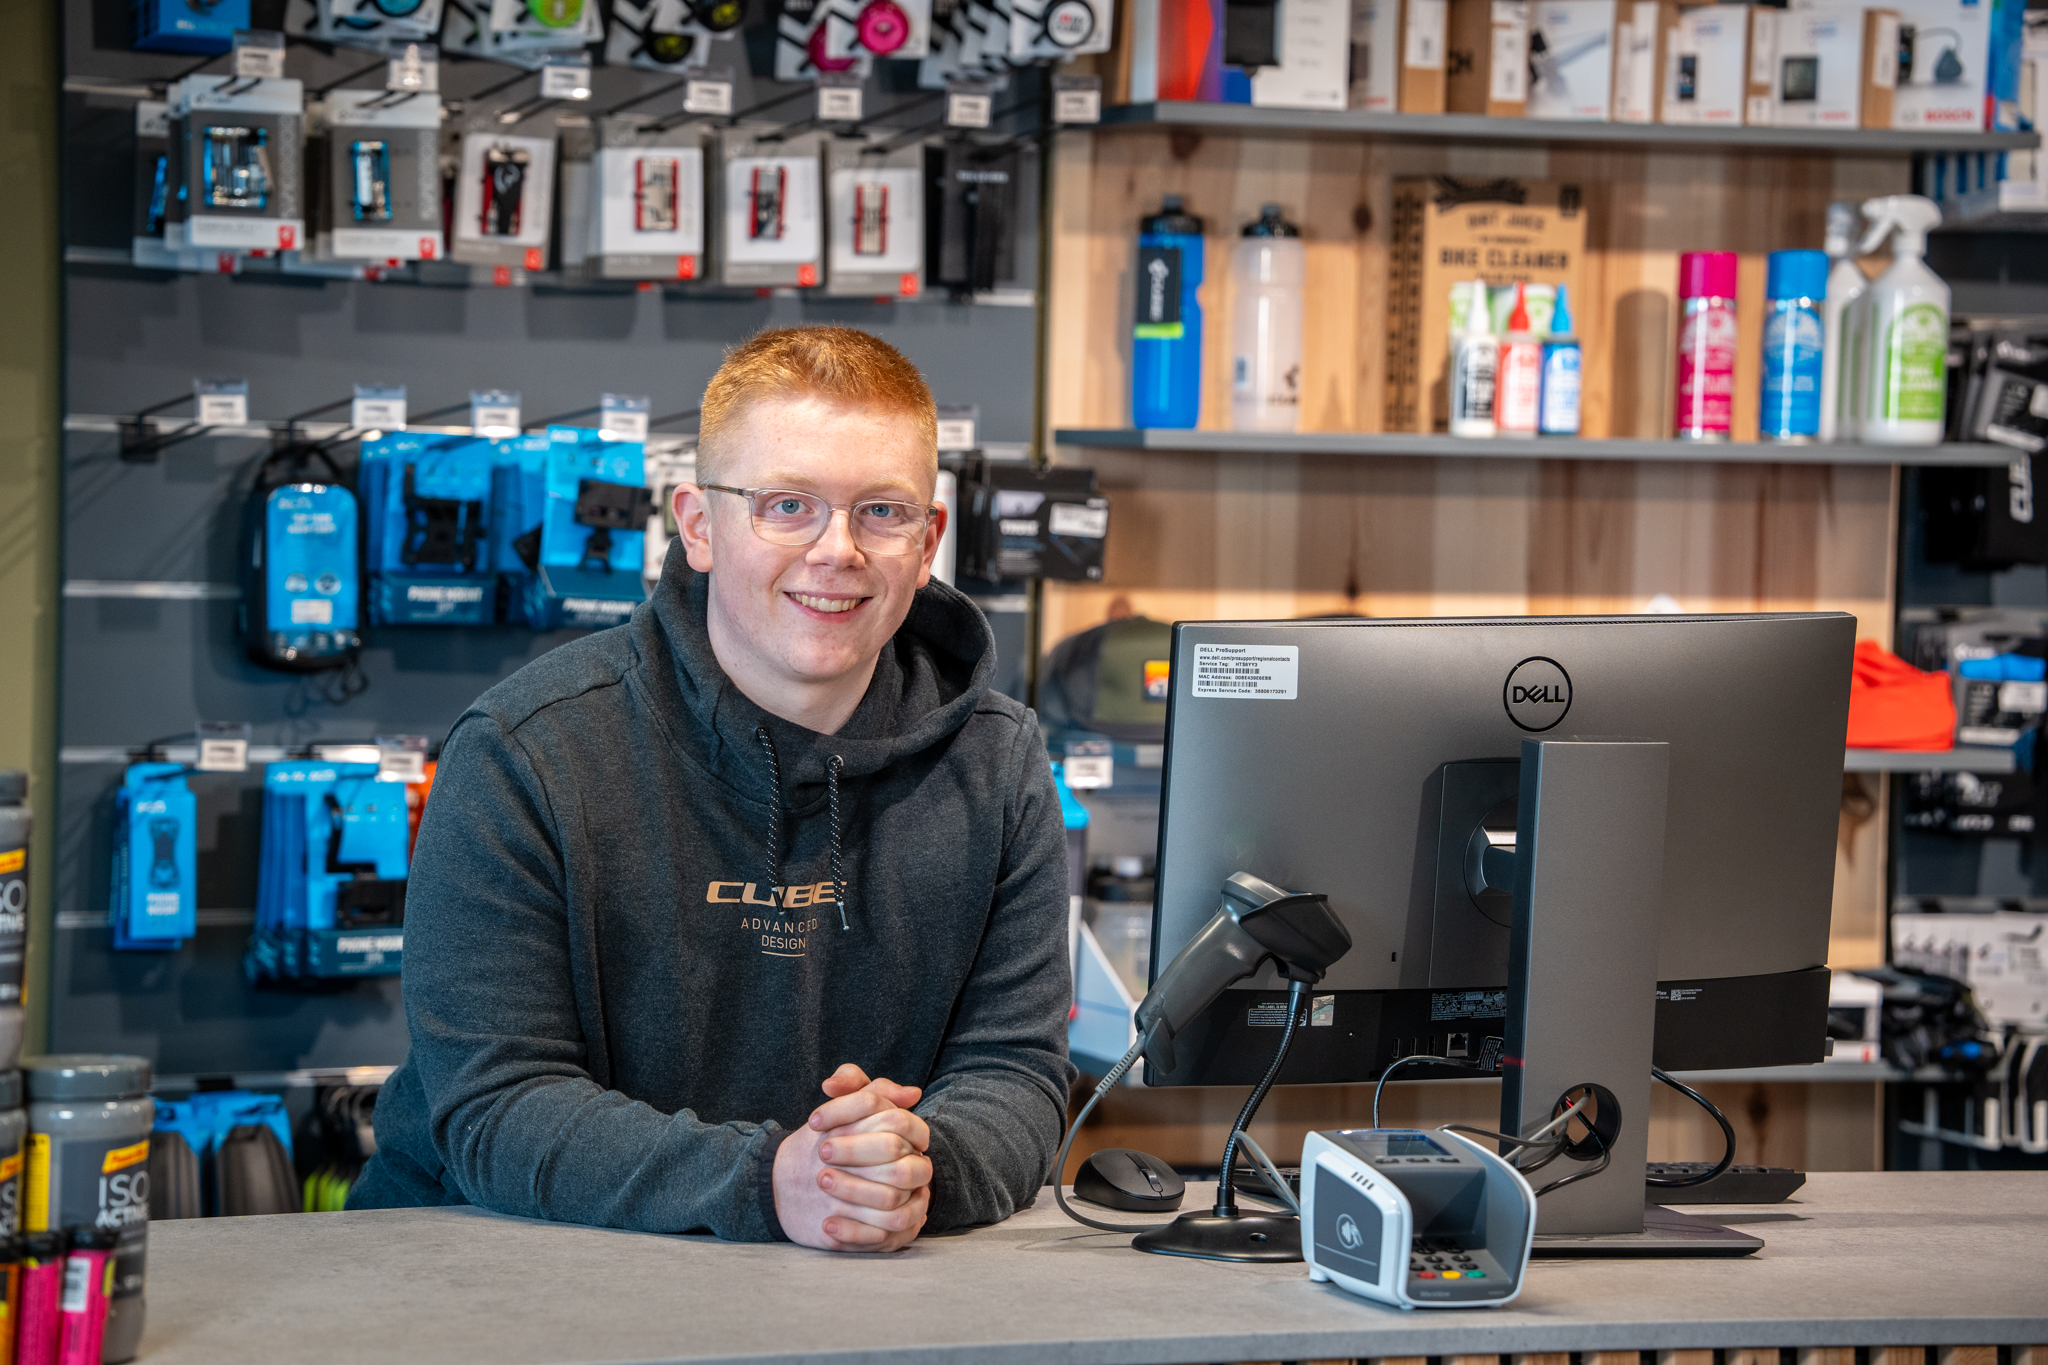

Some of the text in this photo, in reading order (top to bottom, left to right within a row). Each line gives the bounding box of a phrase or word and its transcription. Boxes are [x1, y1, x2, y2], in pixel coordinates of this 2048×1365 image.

[1512, 684, 1565, 704] DELL
[706, 880, 848, 908] CUBE
[740, 917, 818, 933] ADVANCED
[761, 934, 806, 950] DESIGN
[98, 1170, 150, 1209] ISO
